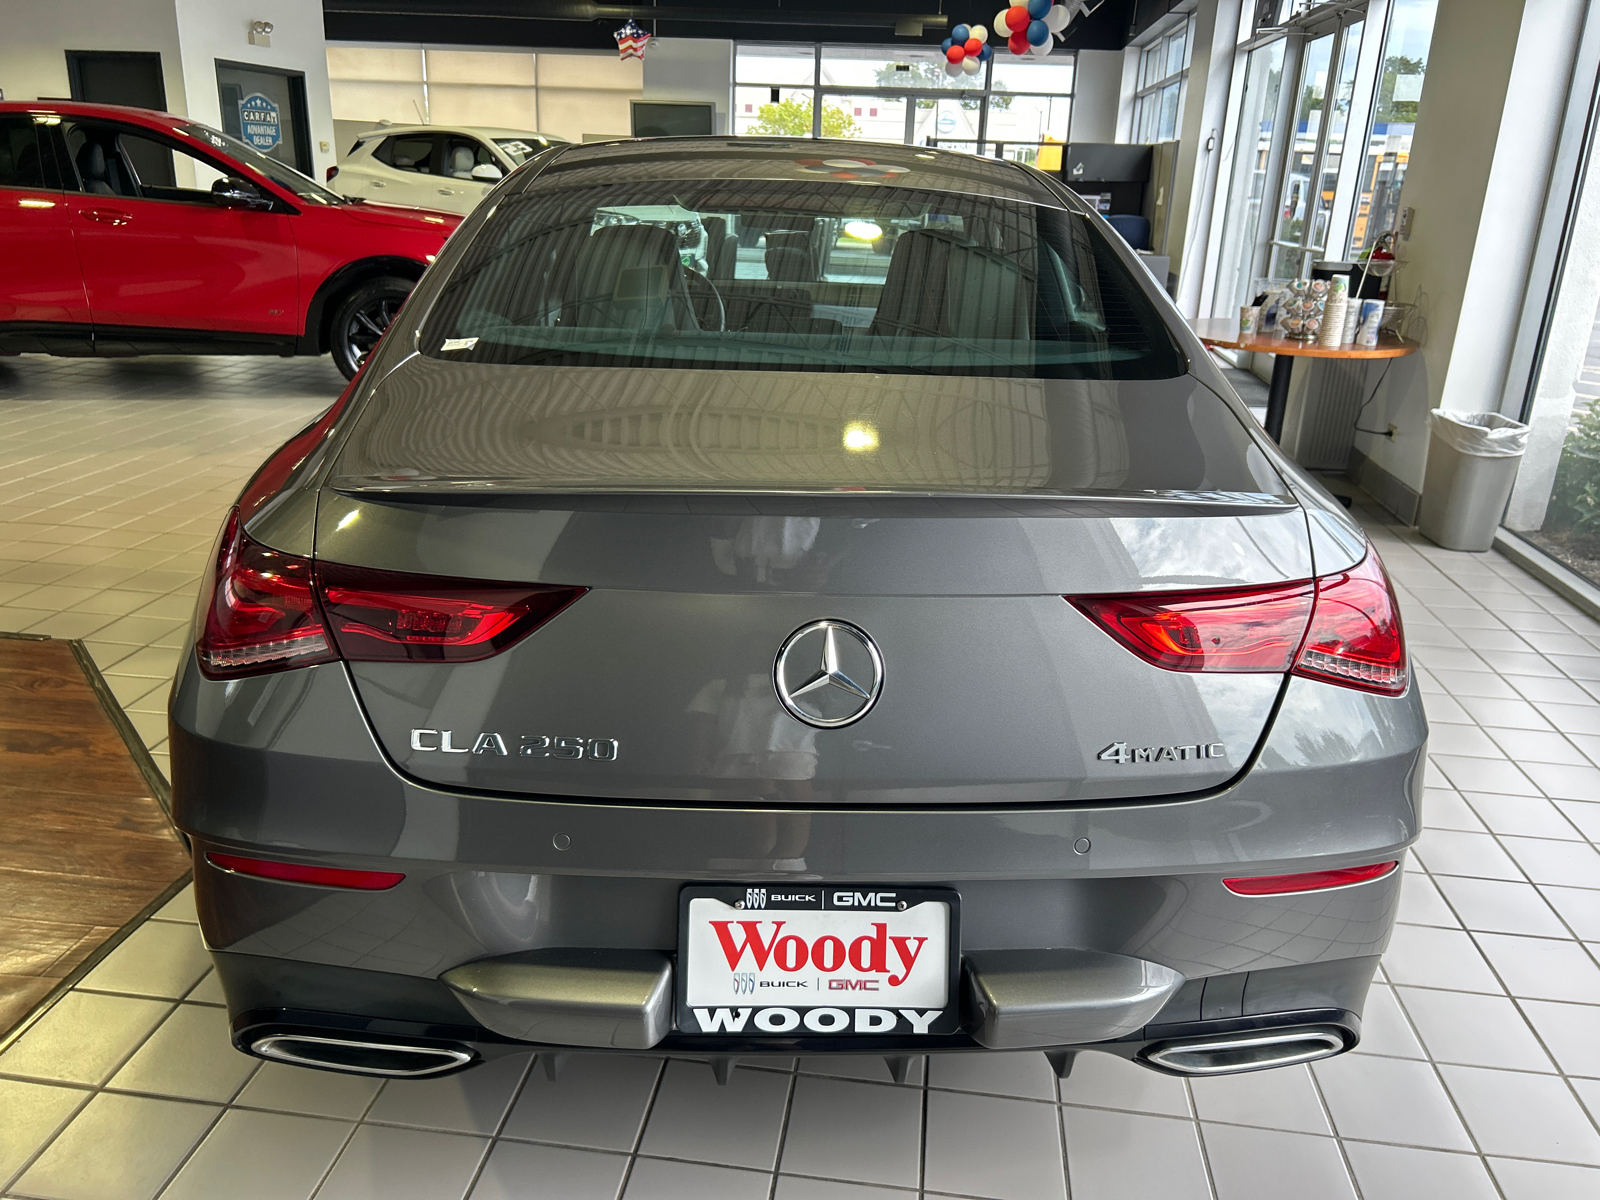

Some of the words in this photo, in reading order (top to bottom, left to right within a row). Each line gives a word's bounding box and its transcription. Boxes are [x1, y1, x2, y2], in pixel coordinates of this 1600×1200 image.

[247, 125, 276, 135] ADVANTAGE
[253, 135, 273, 146] DEALER
[410, 728, 508, 756] CLA
[519, 735, 619, 761] 250
[1097, 741, 1224, 764] 4MATIC
[770, 894, 817, 902] BUICK
[833, 891, 897, 907] GMC
[709, 920, 929, 987] Woody
[759, 980, 809, 988] BUICK
[828, 979, 880, 991] GMC
[693, 1007, 944, 1034] WOODY
